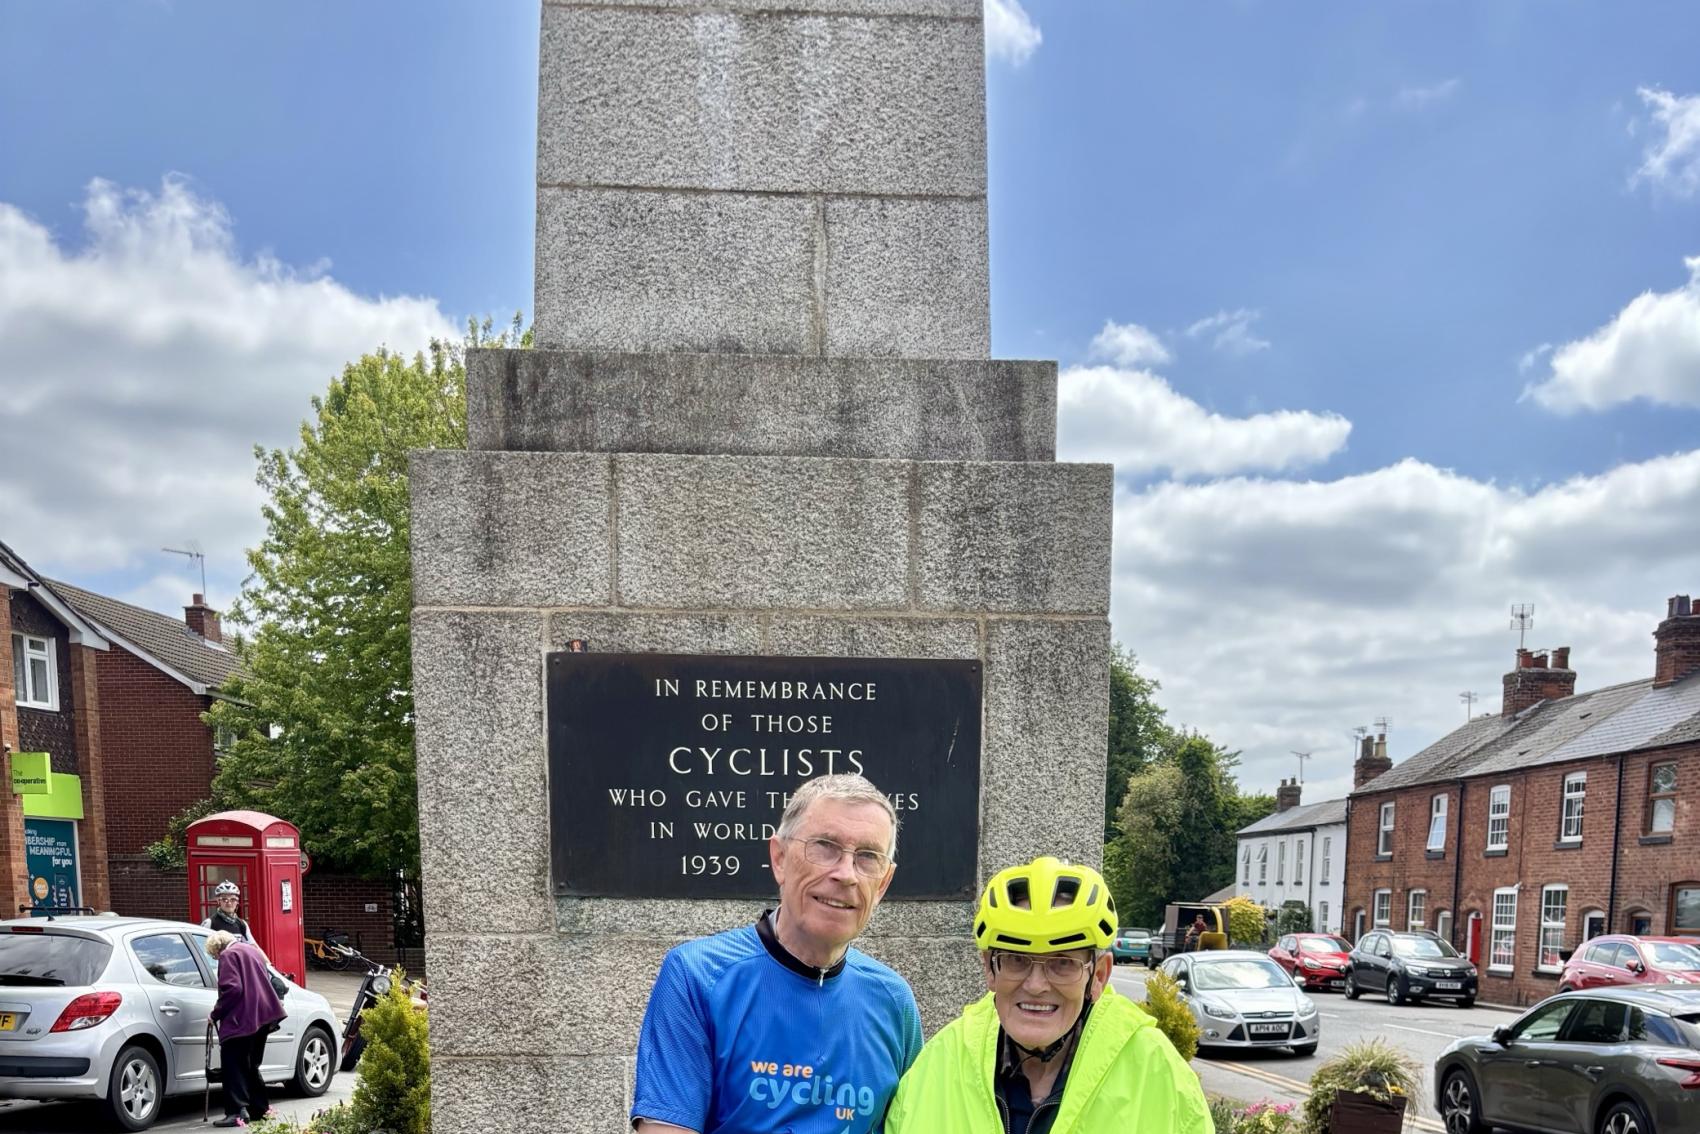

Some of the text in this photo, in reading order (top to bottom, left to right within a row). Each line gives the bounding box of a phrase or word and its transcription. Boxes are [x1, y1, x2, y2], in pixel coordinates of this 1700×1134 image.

[655, 679, 877, 701] IN REMEMBRANCE
[701, 713, 833, 733] OF THOSE
[668, 747, 865, 777] CYCLISTS
[608, 788, 667, 807] WHO
[686, 789, 747, 809] GAVE
[25, 836, 56, 846] BERSHIP
[650, 822, 776, 841] IN WORLD
[29, 846, 72, 856] MEANINGFUL
[52, 856, 73, 868] for you
[680, 856, 740, 875] 1939
[751, 1060, 814, 1079] we are
[749, 1075, 875, 1116] cycling
[835, 1107, 856, 1120] UK
